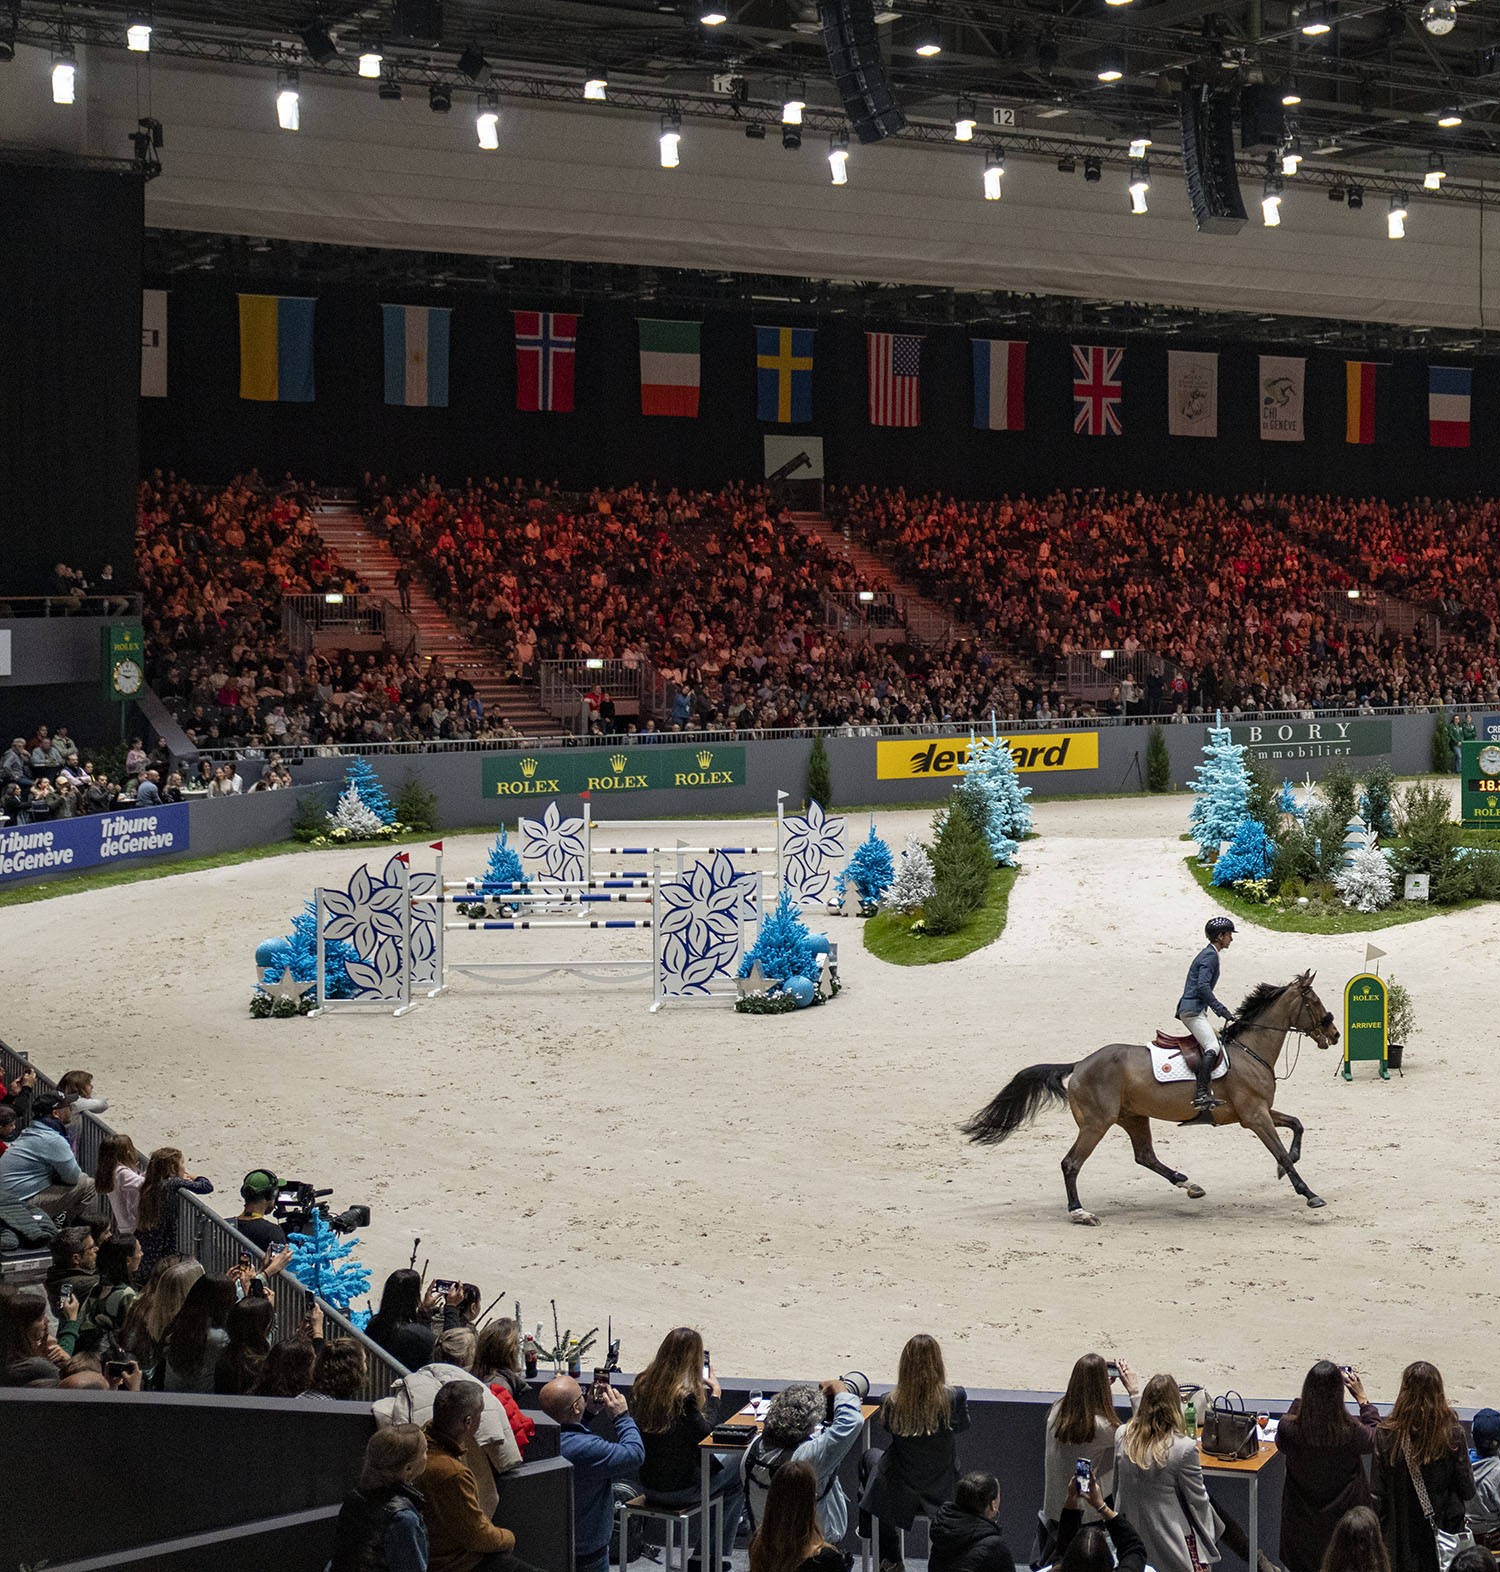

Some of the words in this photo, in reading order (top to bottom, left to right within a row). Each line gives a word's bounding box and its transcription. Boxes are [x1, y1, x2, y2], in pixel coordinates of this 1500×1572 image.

[995, 109, 1013, 125] 12
[1263, 406, 1278, 419] CHI
[1250, 722, 1351, 742] BORY
[587, 775, 649, 790] ROLEX
[674, 771, 734, 786] ROLEX
[496, 779, 561, 795] ROLEX
[100, 815, 158, 838] Tribune
[100, 831, 174, 858] deGenève
[1353, 994, 1380, 1002] ROLEX
